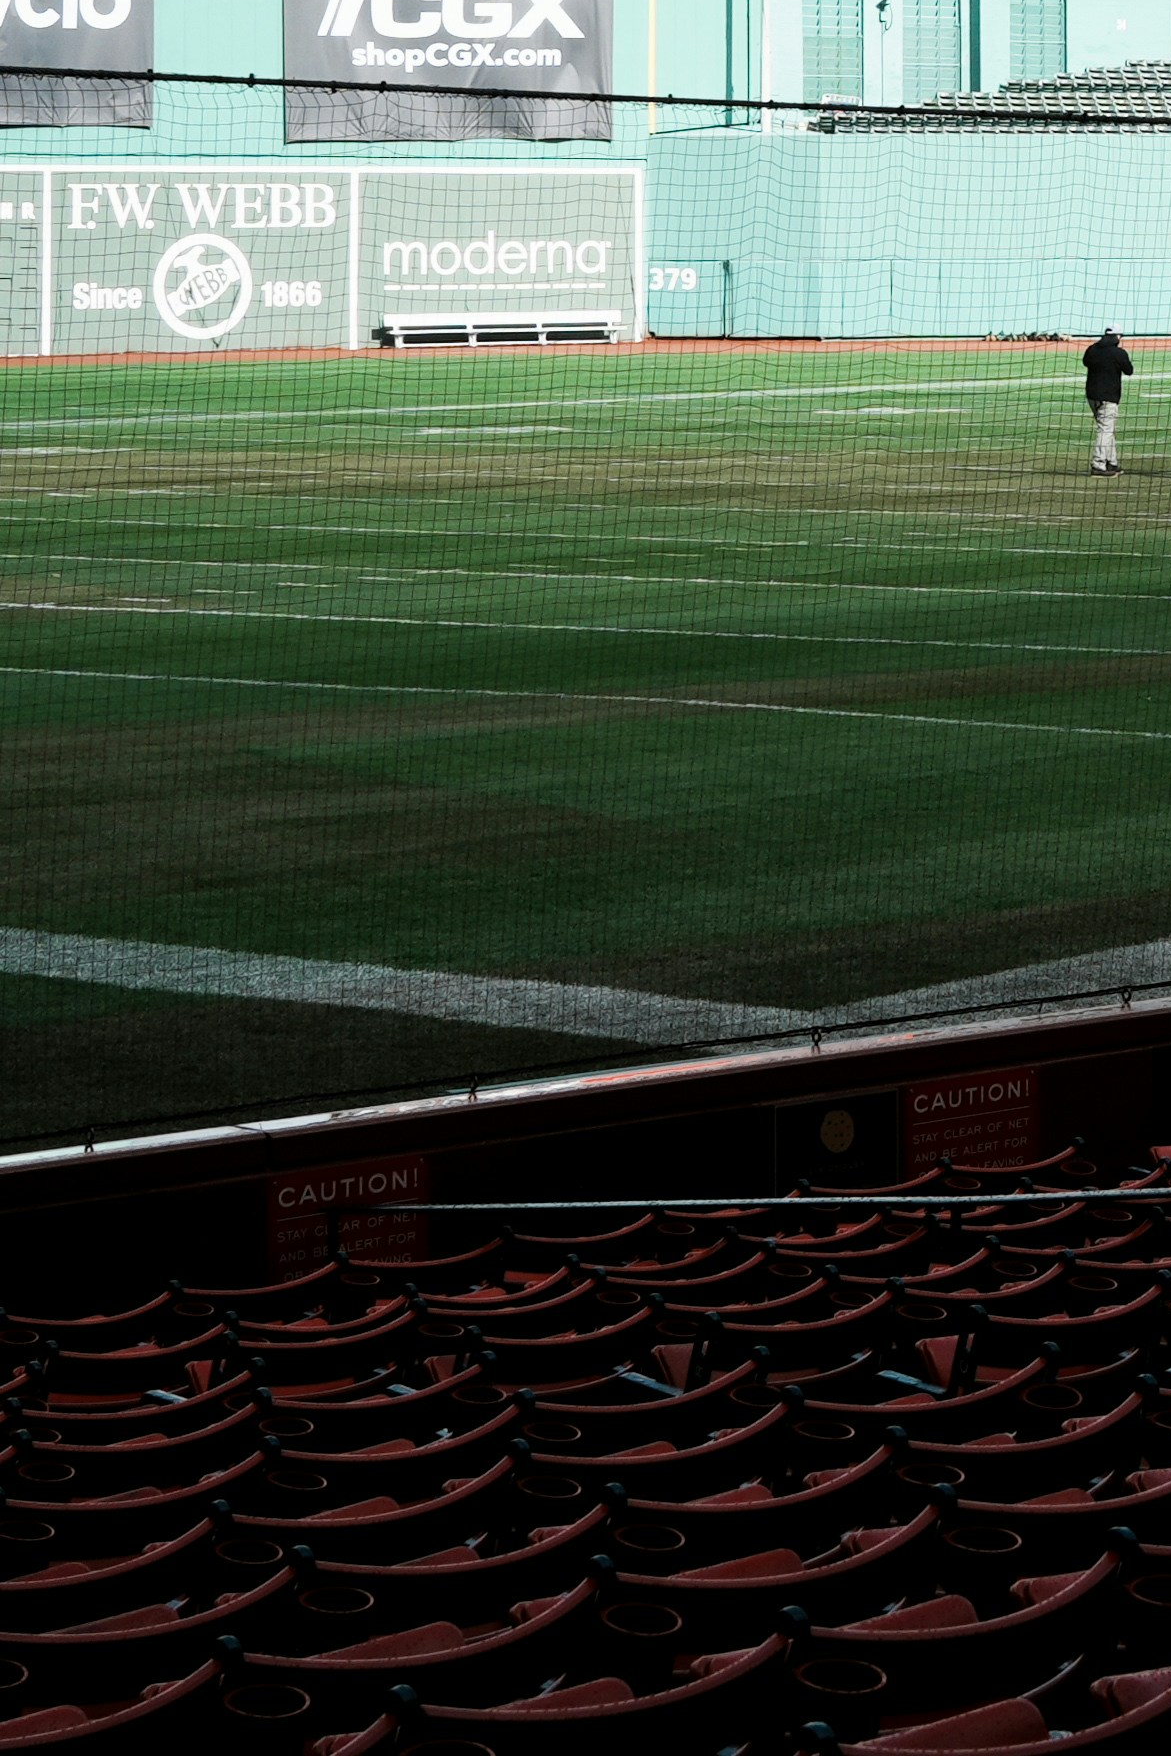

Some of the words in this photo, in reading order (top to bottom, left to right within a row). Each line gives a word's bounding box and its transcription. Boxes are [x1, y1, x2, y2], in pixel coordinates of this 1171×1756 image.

[352, 42, 562, 83] shopCGX.com
[22, 202, 36, 220] R
[67, 183, 161, 229] F.W.
[175, 183, 336, 228] WEBB
[384, 230, 611, 275] moderna
[72, 282, 143, 310] Since
[261, 281, 322, 308] 1866
[177, 266, 229, 306] WEBB
[649, 268, 697, 291] 379
[913, 1078, 1029, 1114] CAUTION!
[912, 1132, 939, 1145] STAY
[943, 1125, 982, 1140] CLEAR
[987, 1121, 1004, 1133] OF
[1008, 1117, 1029, 1130] NET
[914, 1151, 937, 1164] AND
[942, 1147, 958, 1158] BE
[963, 1141, 999, 1156] ALERT
[1004, 1136, 1027, 1148] FOR
[278, 1167, 418, 1208] CAUTION!
[276, 1227, 307, 1243] STAY
[367, 1215, 387, 1228] OF
[279, 1249, 306, 1264] AND
[313, 1245, 329, 1259] BE
[338, 1237, 381, 1255] ALERT
[388, 1231, 417, 1245] FOR
